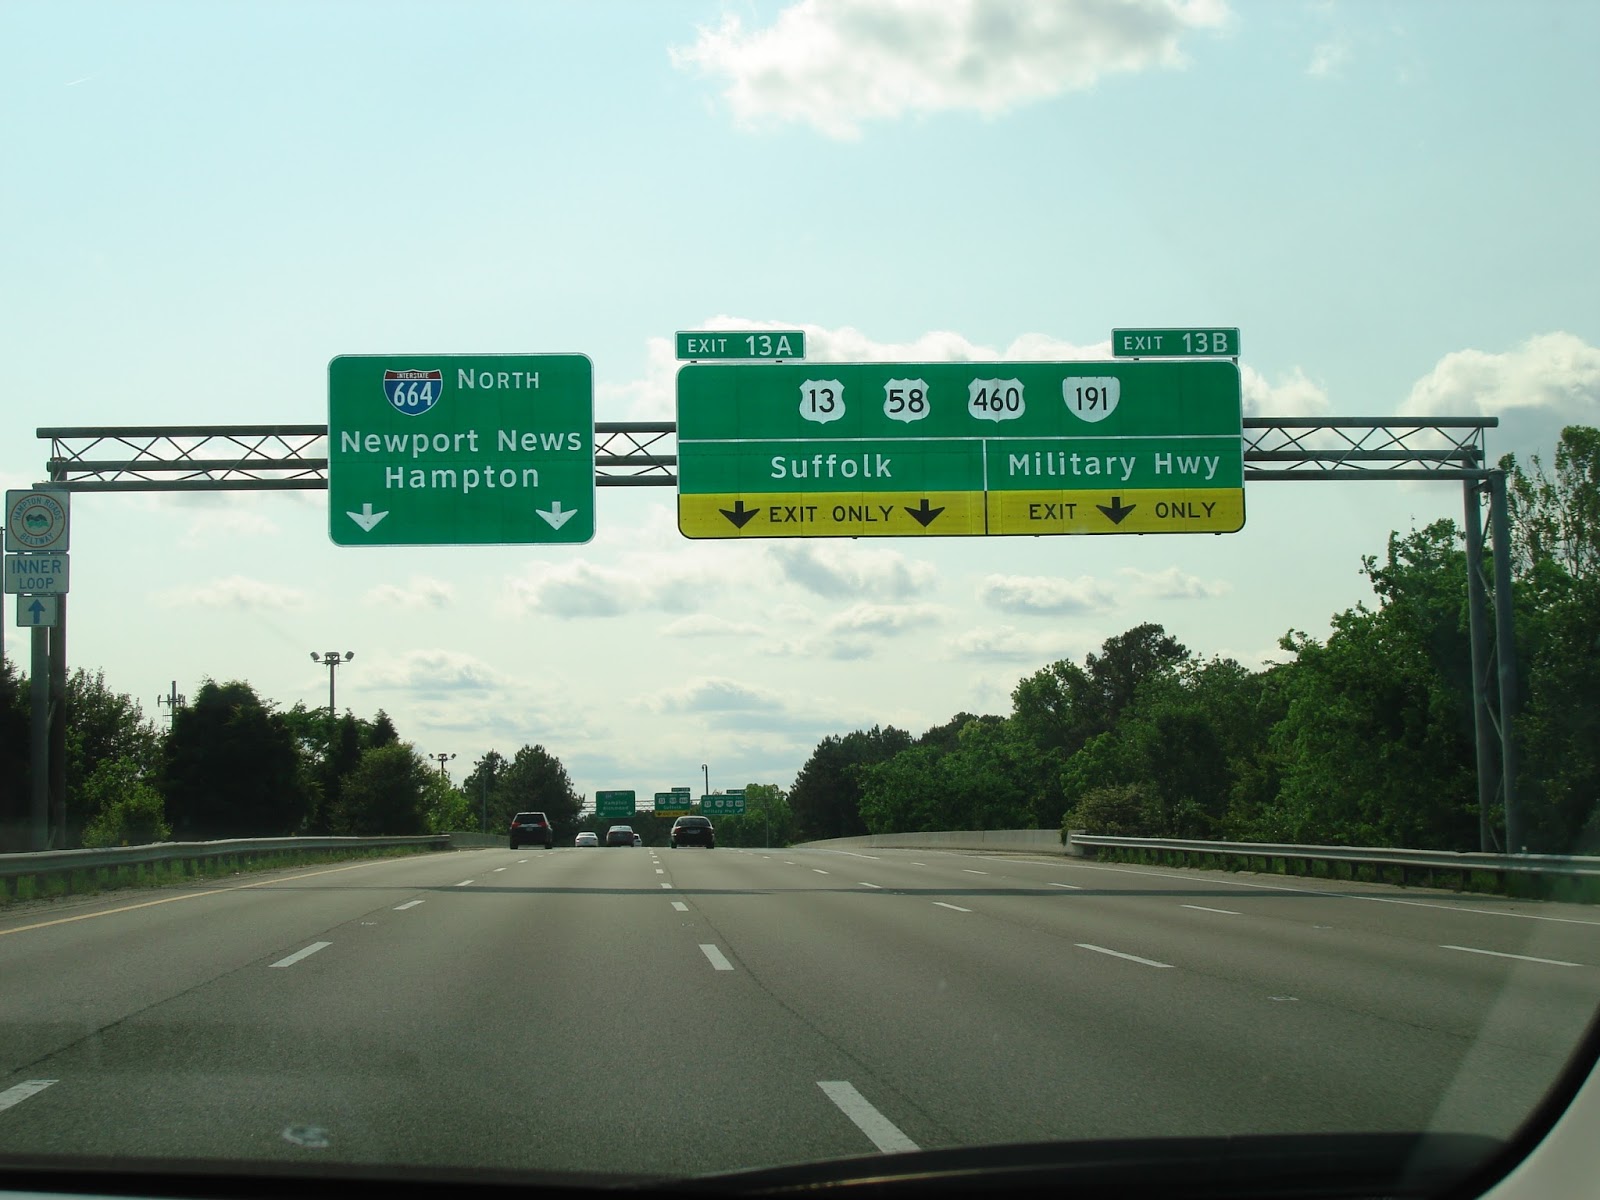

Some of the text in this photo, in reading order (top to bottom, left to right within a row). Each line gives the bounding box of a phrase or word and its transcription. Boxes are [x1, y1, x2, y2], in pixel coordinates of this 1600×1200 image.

[687, 335, 793, 356] EXIT 13A
[1123, 332, 1229, 353] EXIT 13B
[457, 368, 540, 389] NORTH
[393, 381, 433, 407] 664
[809, 388, 835, 413] 13
[888, 388, 925, 413] 58
[973, 387, 1020, 412] 460
[1075, 386, 1108, 411] 191
[341, 429, 582, 459] Newport News
[770, 453, 892, 479] Suffolk
[1008, 451, 1220, 481] Military Hwy
[385, 464, 540, 494] Hampton
[13, 496, 63, 521] HAMPTON ROADS
[769, 505, 894, 522] EXIT ONLY
[1029, 501, 1216, 520] EXIT ONLY
[19, 532, 55, 545] BELTWAY
[12, 559, 62, 574] INNER
[19, 577, 54, 590] LOOP
